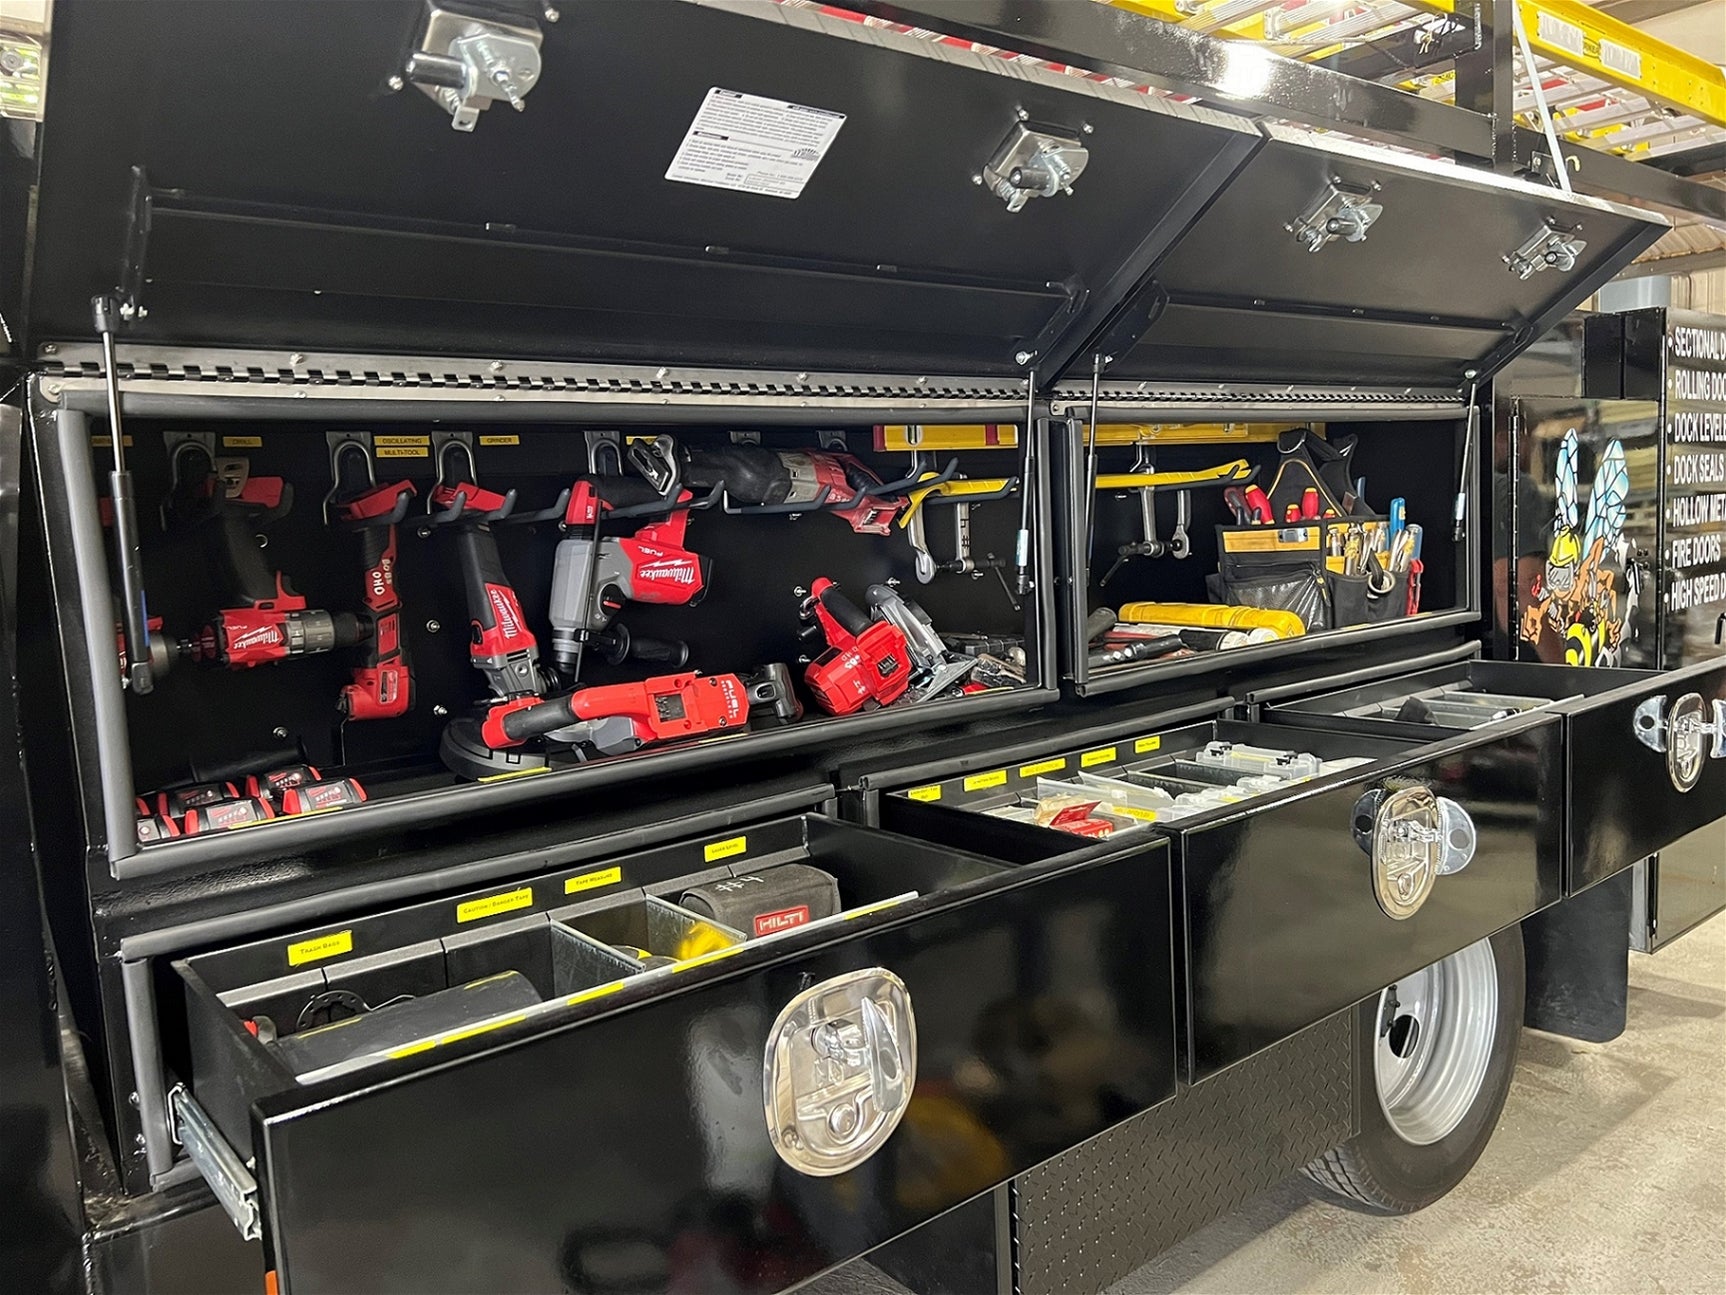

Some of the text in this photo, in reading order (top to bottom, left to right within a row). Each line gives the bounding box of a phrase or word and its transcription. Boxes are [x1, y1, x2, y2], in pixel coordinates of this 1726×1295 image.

[1675, 326, 1720, 360] SECTIONAL
[1675, 369, 1711, 401] ROLLING
[1674, 412, 1699, 442] DOCK
[1673, 453, 1725, 485] DOCK SEALS
[1672, 494, 1709, 527] HOLLOW
[638, 545, 664, 557] FUEL
[1672, 534, 1722, 569] FIRE DOORS
[639, 566, 696, 585] Milwaukee
[1671, 578, 1694, 612] HIGH
[1694, 574, 1720, 606] SPEED
[490, 589, 518, 640] Milwaukee
[233, 630, 280, 650] Milwaukee
[725, 679, 739, 719] FUEL
[759, 911, 804, 931] HILTI
